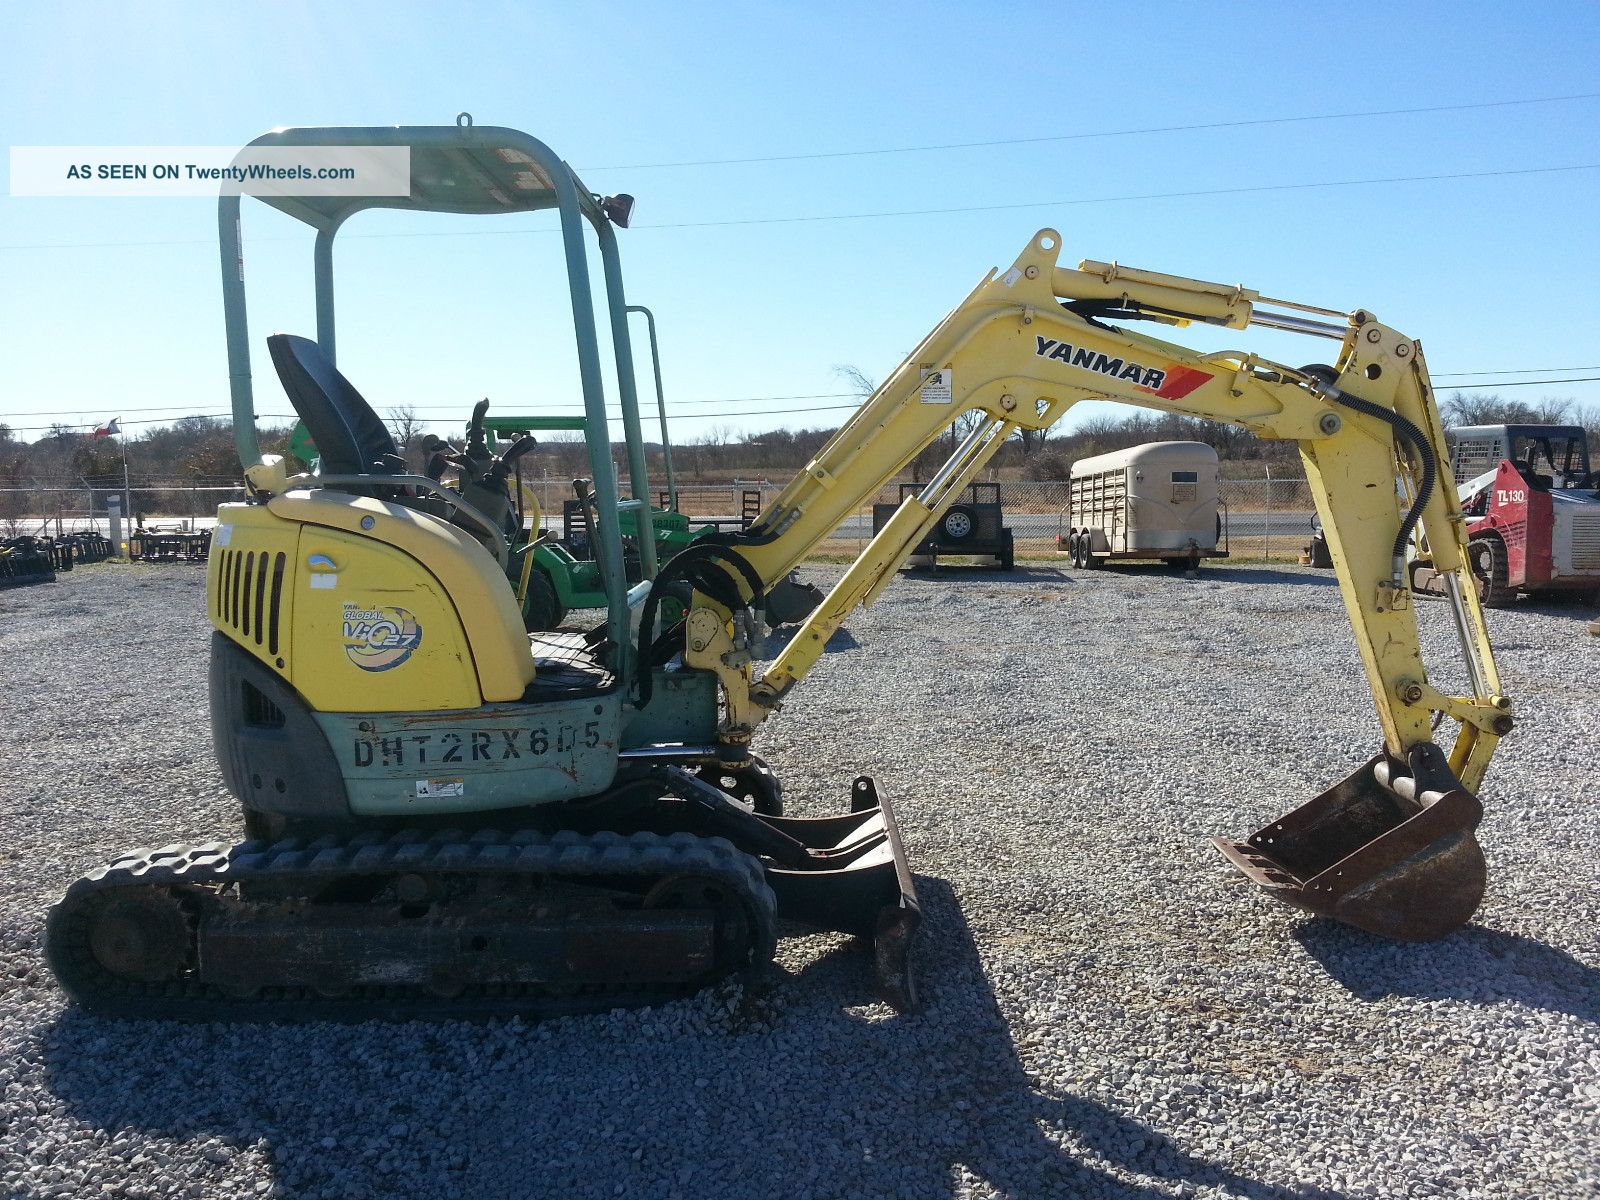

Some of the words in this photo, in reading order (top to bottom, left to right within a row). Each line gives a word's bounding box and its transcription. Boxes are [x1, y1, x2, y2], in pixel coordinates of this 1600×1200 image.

[1036, 335, 1167, 390] YANMAR
[1497, 489, 1525, 502] TL130
[343, 611, 385, 620] GLOBAL
